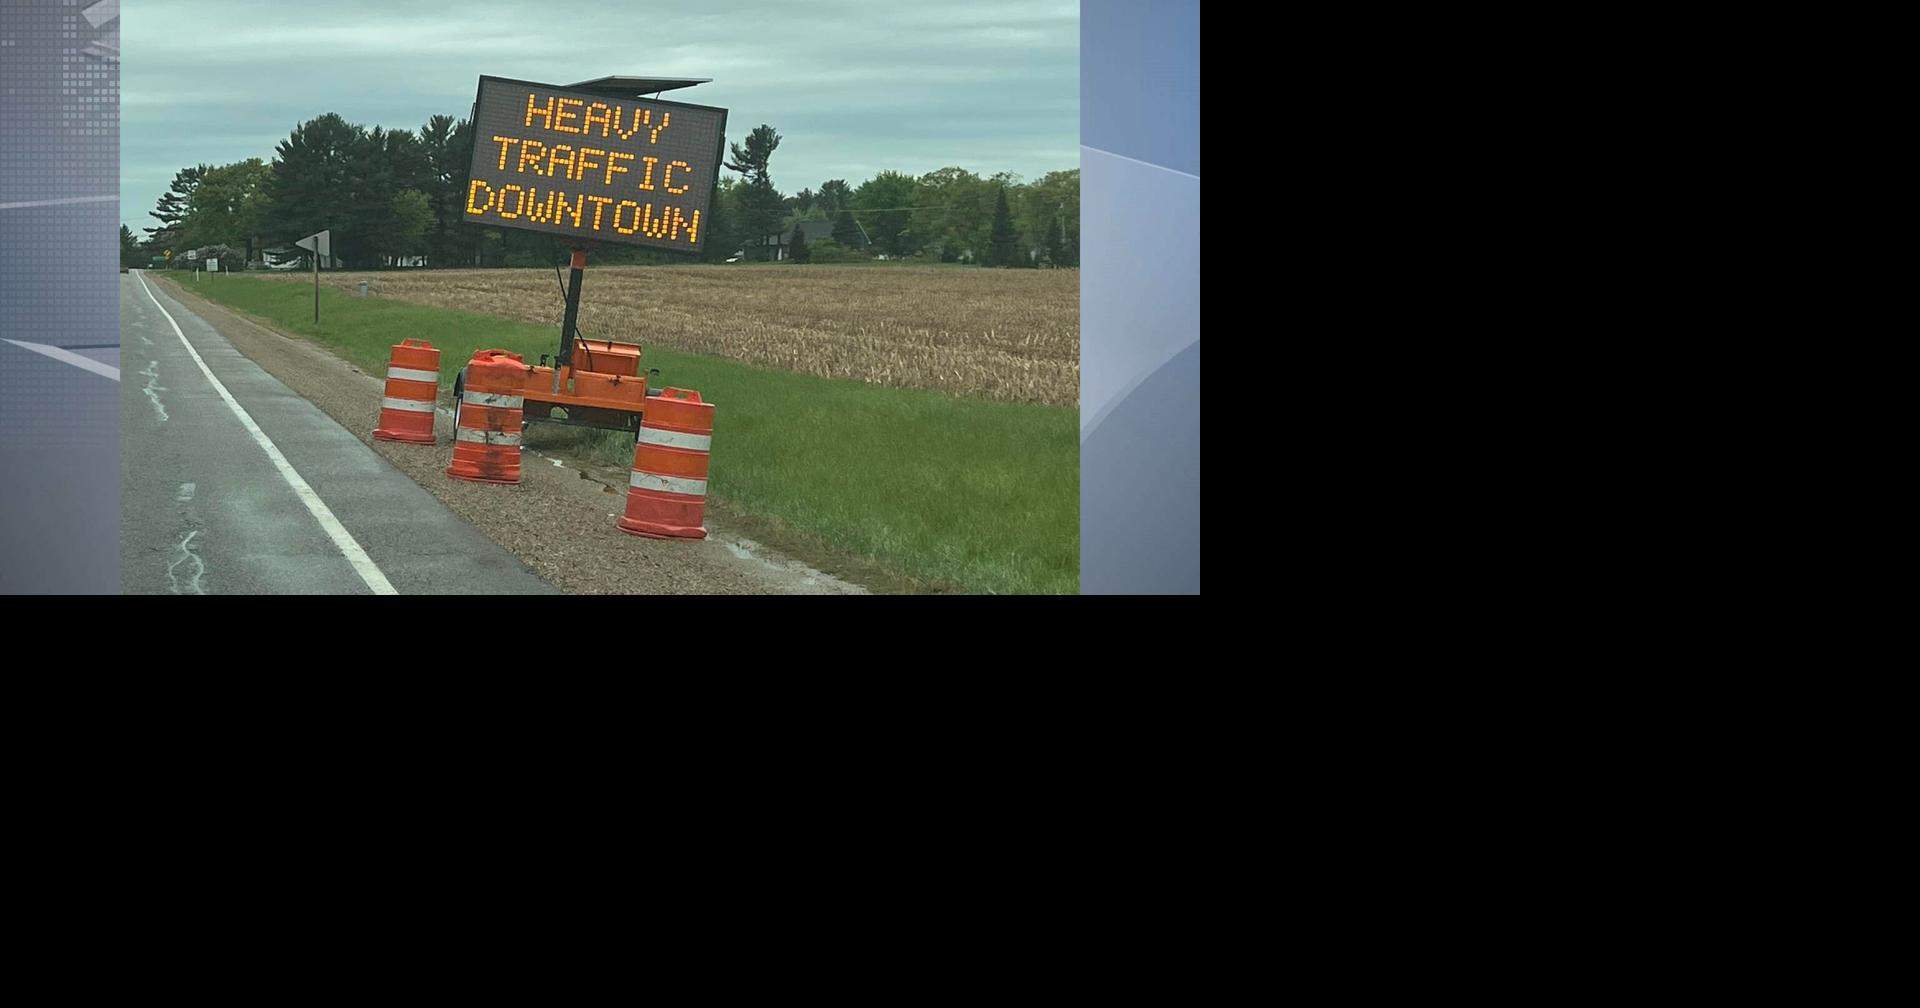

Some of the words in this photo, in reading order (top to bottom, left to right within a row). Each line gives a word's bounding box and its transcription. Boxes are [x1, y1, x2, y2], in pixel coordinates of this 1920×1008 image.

[525, 94, 670, 144] HEAVY
[493, 135, 692, 195] TRAFFIC
[466, 180, 700, 243] DOWNTOWN
